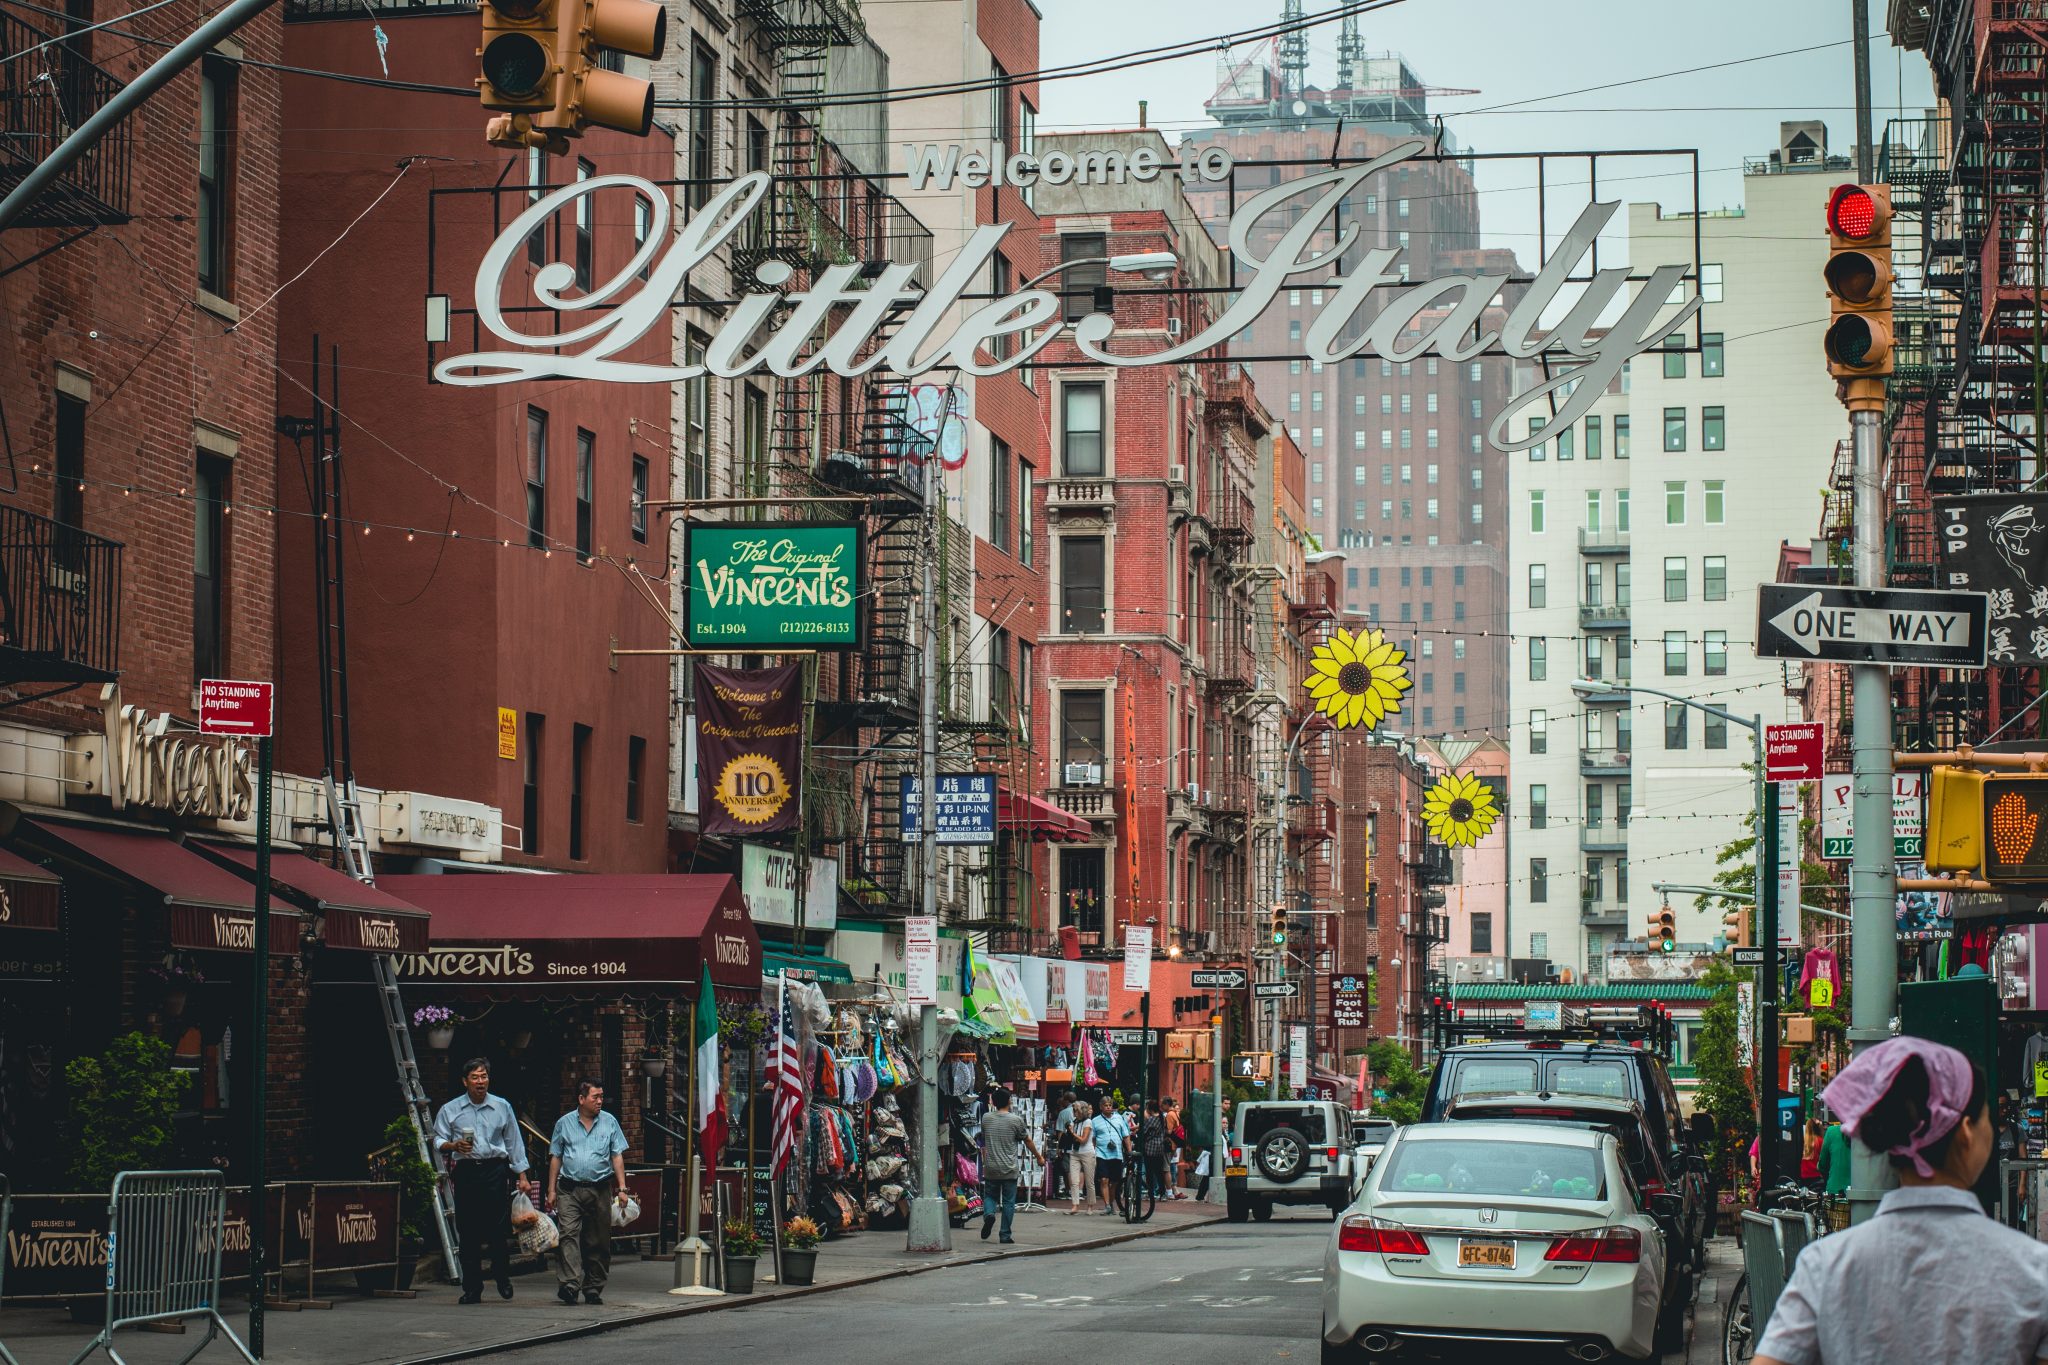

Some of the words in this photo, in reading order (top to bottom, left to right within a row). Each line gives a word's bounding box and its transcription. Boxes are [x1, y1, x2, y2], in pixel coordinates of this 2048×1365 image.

[903, 143, 1161, 192] Welcome
[1179, 138, 1233, 184] to
[433, 170, 1065, 387] Little
[1074, 140, 1704, 452] Italy
[730, 539, 768, 565] The
[769, 538, 844, 576] Original
[697, 624, 717, 634] Est.
[720, 623, 747, 634] 1904
[780, 622, 850, 634] (212)226-8133
[1794, 609, 1856, 639] ONE
[1889, 614, 1956, 643] WAY
[205, 686, 217, 696] NO
[218, 687, 260, 698] STANDING
[715, 685, 768, 702] Welcome
[771, 690, 783, 700] to
[204, 697, 240, 710] Anytime
[738, 706, 762, 721] The
[702, 720, 752, 740] Original
[1769, 731, 1779, 741] NO
[1780, 728, 1815, 740] STANDING
[1769, 743, 1798, 755] Anytime
[734, 771, 775, 797] 110
[723, 795, 784, 806] ANNIVERSARY
[765, 854, 785, 888] CITY
[1934, 930, 1952, 939] Rub
[1740, 952, 1757, 960] ONE
[547, 962, 588, 976] Since
[591, 961, 627, 975] 1904
[1195, 975, 1213, 983] ONE
[1222, 975, 1240, 983] WAY
[1278, 985, 1292, 993] WAY
[1335, 999, 1362, 1007] Foot
[1333, 1010, 1364, 1018] Back
[1337, 1018, 1361, 1026] Rub
[31, 1220, 64, 1228] ESTABLISHED
[107, 1234, 116, 1287] NYPD
